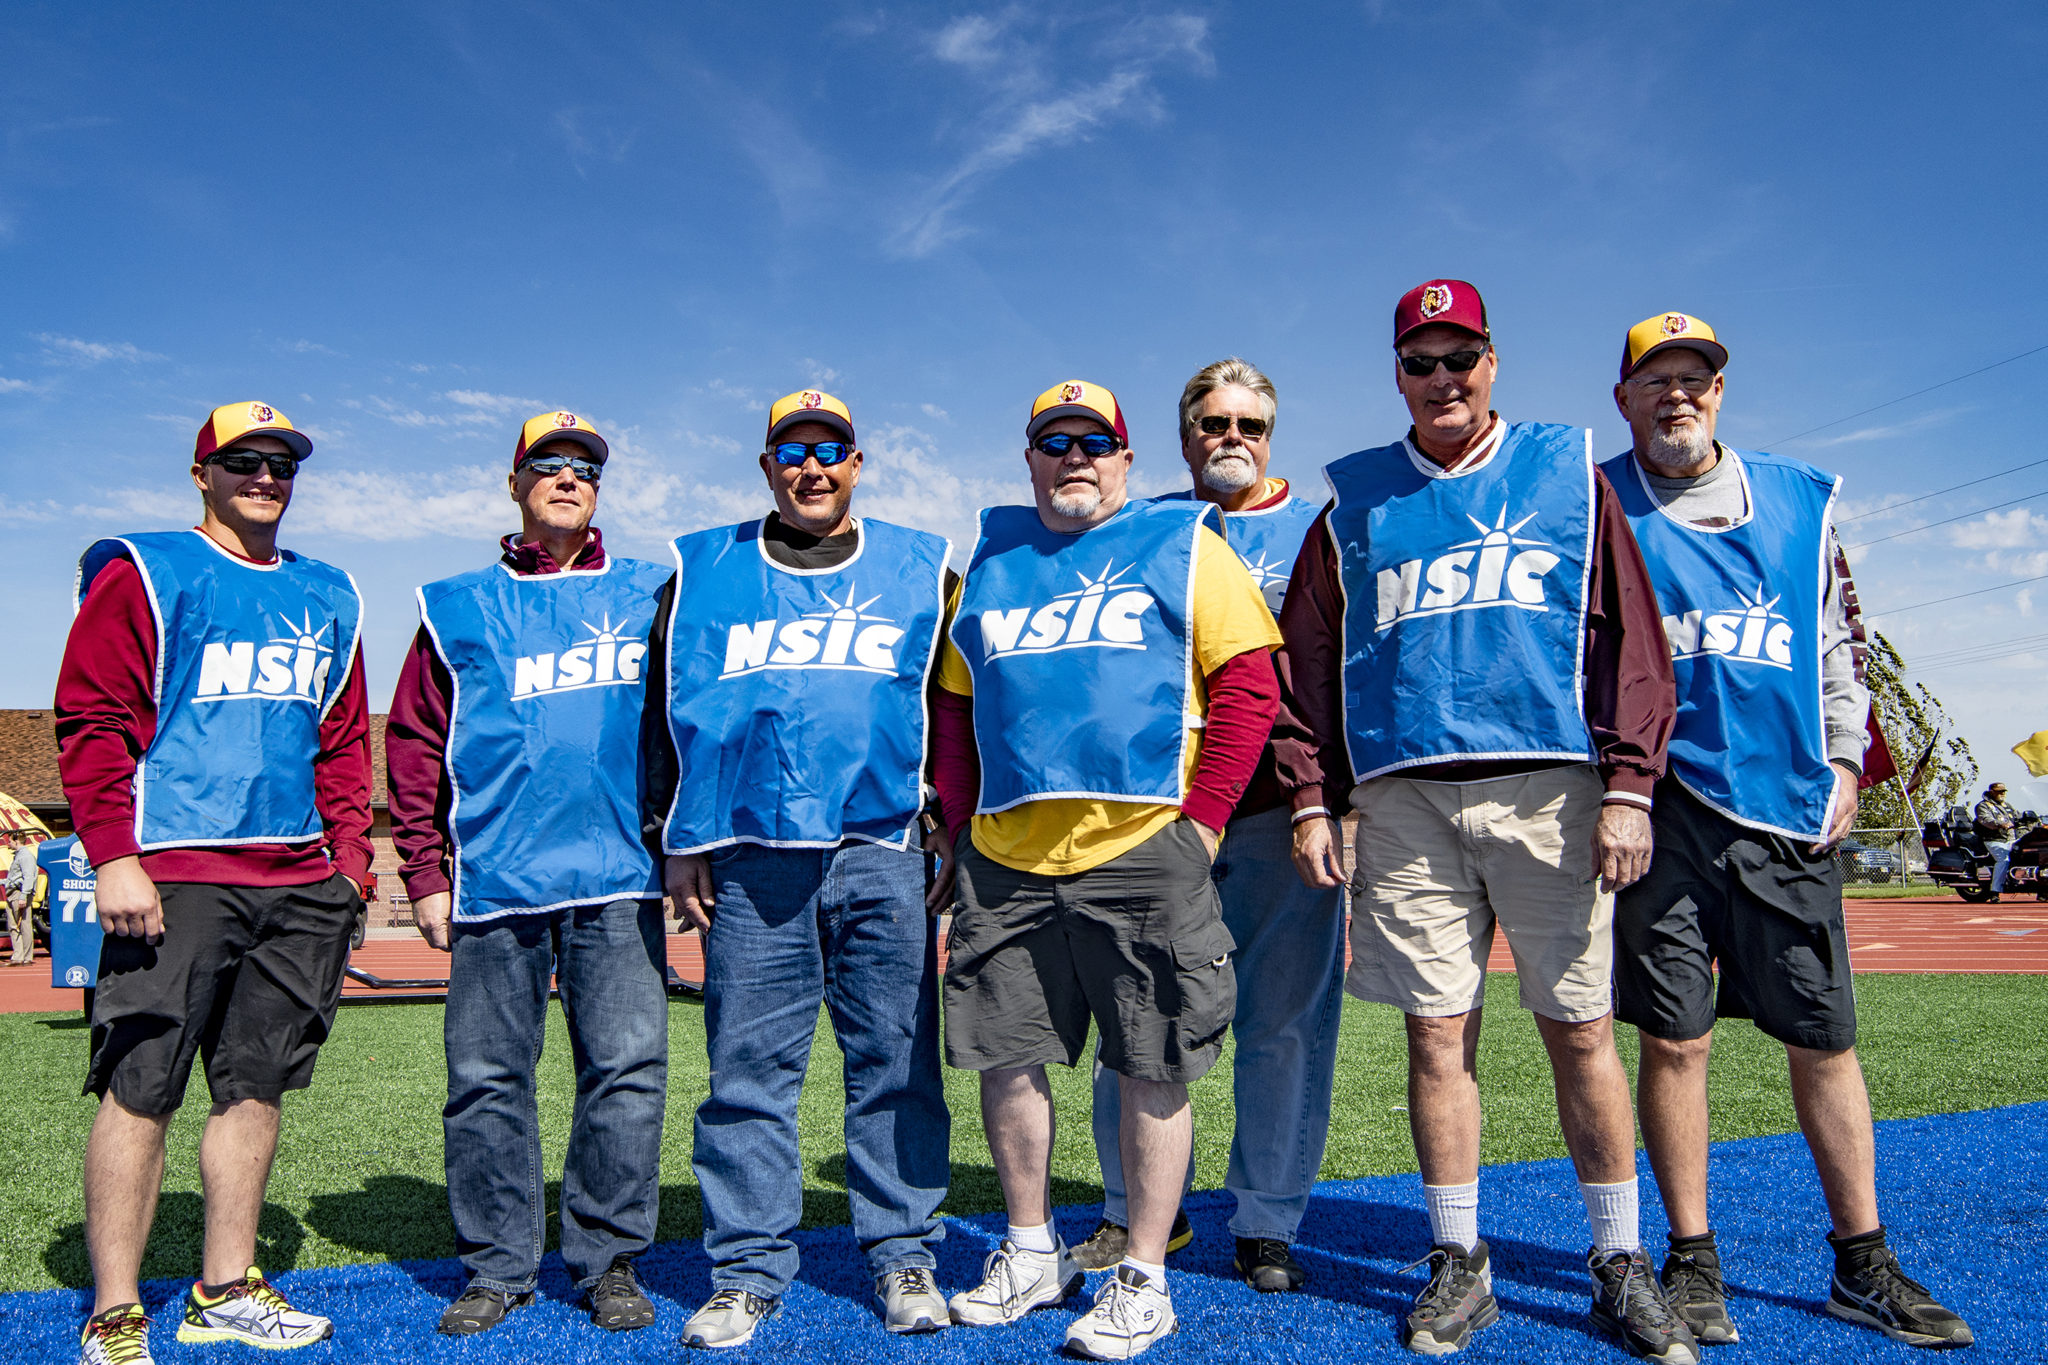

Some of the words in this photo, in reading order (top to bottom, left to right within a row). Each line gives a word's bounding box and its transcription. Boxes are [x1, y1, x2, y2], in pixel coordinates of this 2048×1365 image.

[1377, 531, 1561, 625] NSIC
[723, 608, 905, 674] NSIC
[980, 582, 1155, 658] NSIC
[1662, 606, 1794, 664] NSIC
[514, 632, 647, 696] NSIC
[58, 890, 97, 923] 77
